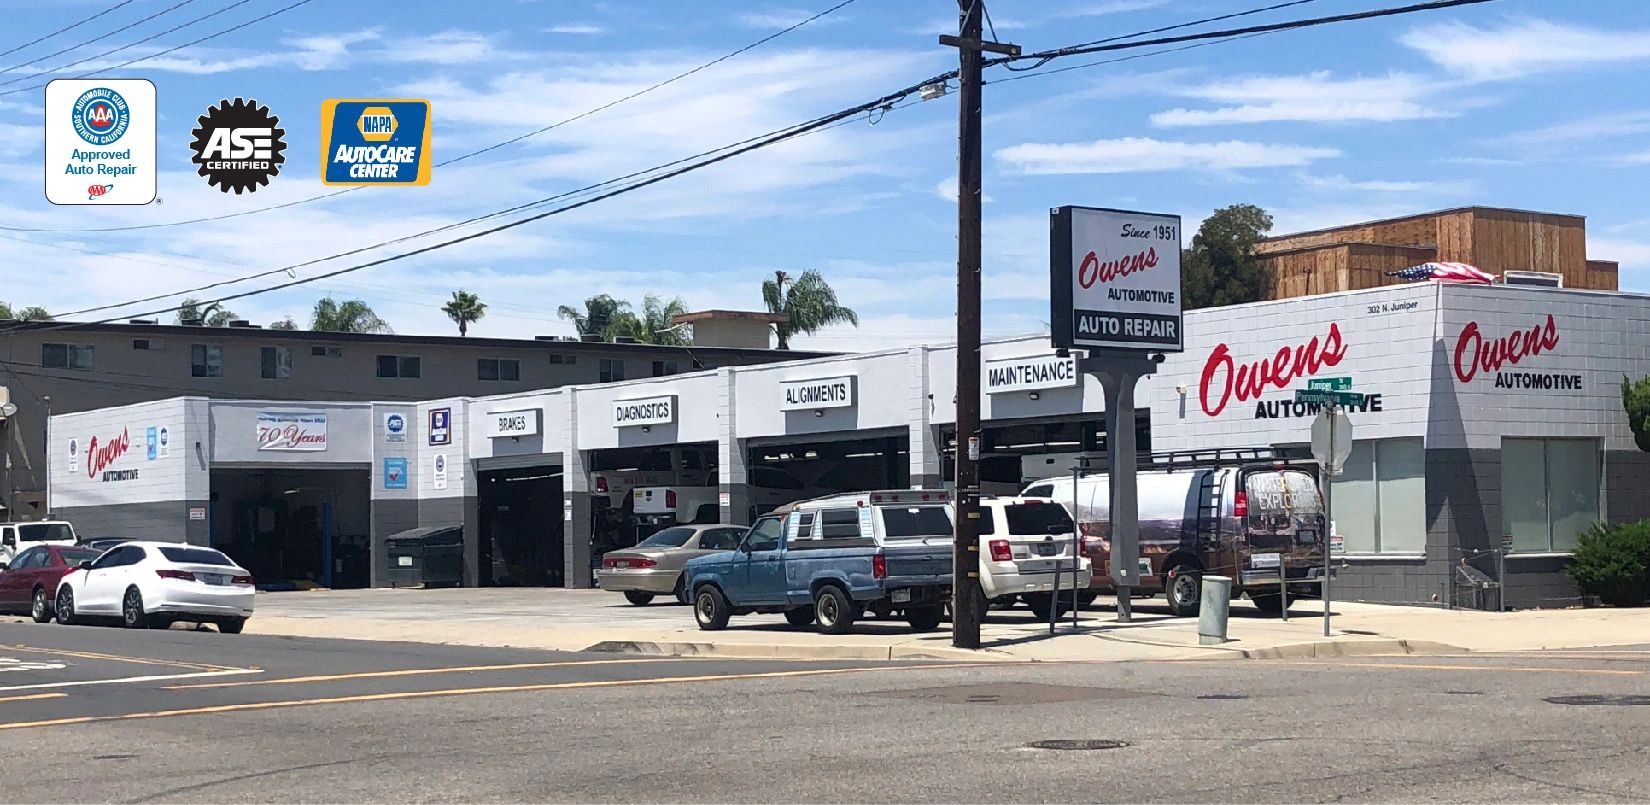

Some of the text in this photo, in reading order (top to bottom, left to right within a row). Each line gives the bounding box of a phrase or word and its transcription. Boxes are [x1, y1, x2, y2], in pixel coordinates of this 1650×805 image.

[1120, 223, 1176, 241] Since 1951
[1078, 246, 1159, 289] Owens
[1108, 287, 1175, 304] AUTOMOTIVE
[1367, 304, 1380, 314] 302
[1390, 300, 1418, 312] Juniper
[1078, 315, 1176, 338] AUTO REPAIR
[1454, 313, 1560, 383] Owens
[988, 359, 1074, 387] MAINTENANCE
[1199, 322, 1348, 417] Owens
[1495, 372, 1582, 390] AUTOMOTIVE
[786, 383, 846, 404] ALIGNMENTS
[616, 402, 669, 421] DIAGNOSTICS
[1255, 394, 1382, 420] AUTOMVE
[499, 415, 526, 432] BRAKES
[259, 423, 326, 448] 70 Years
[88, 425, 131, 479] Owens
[102, 468, 139, 483] AUTOMOTIVE
